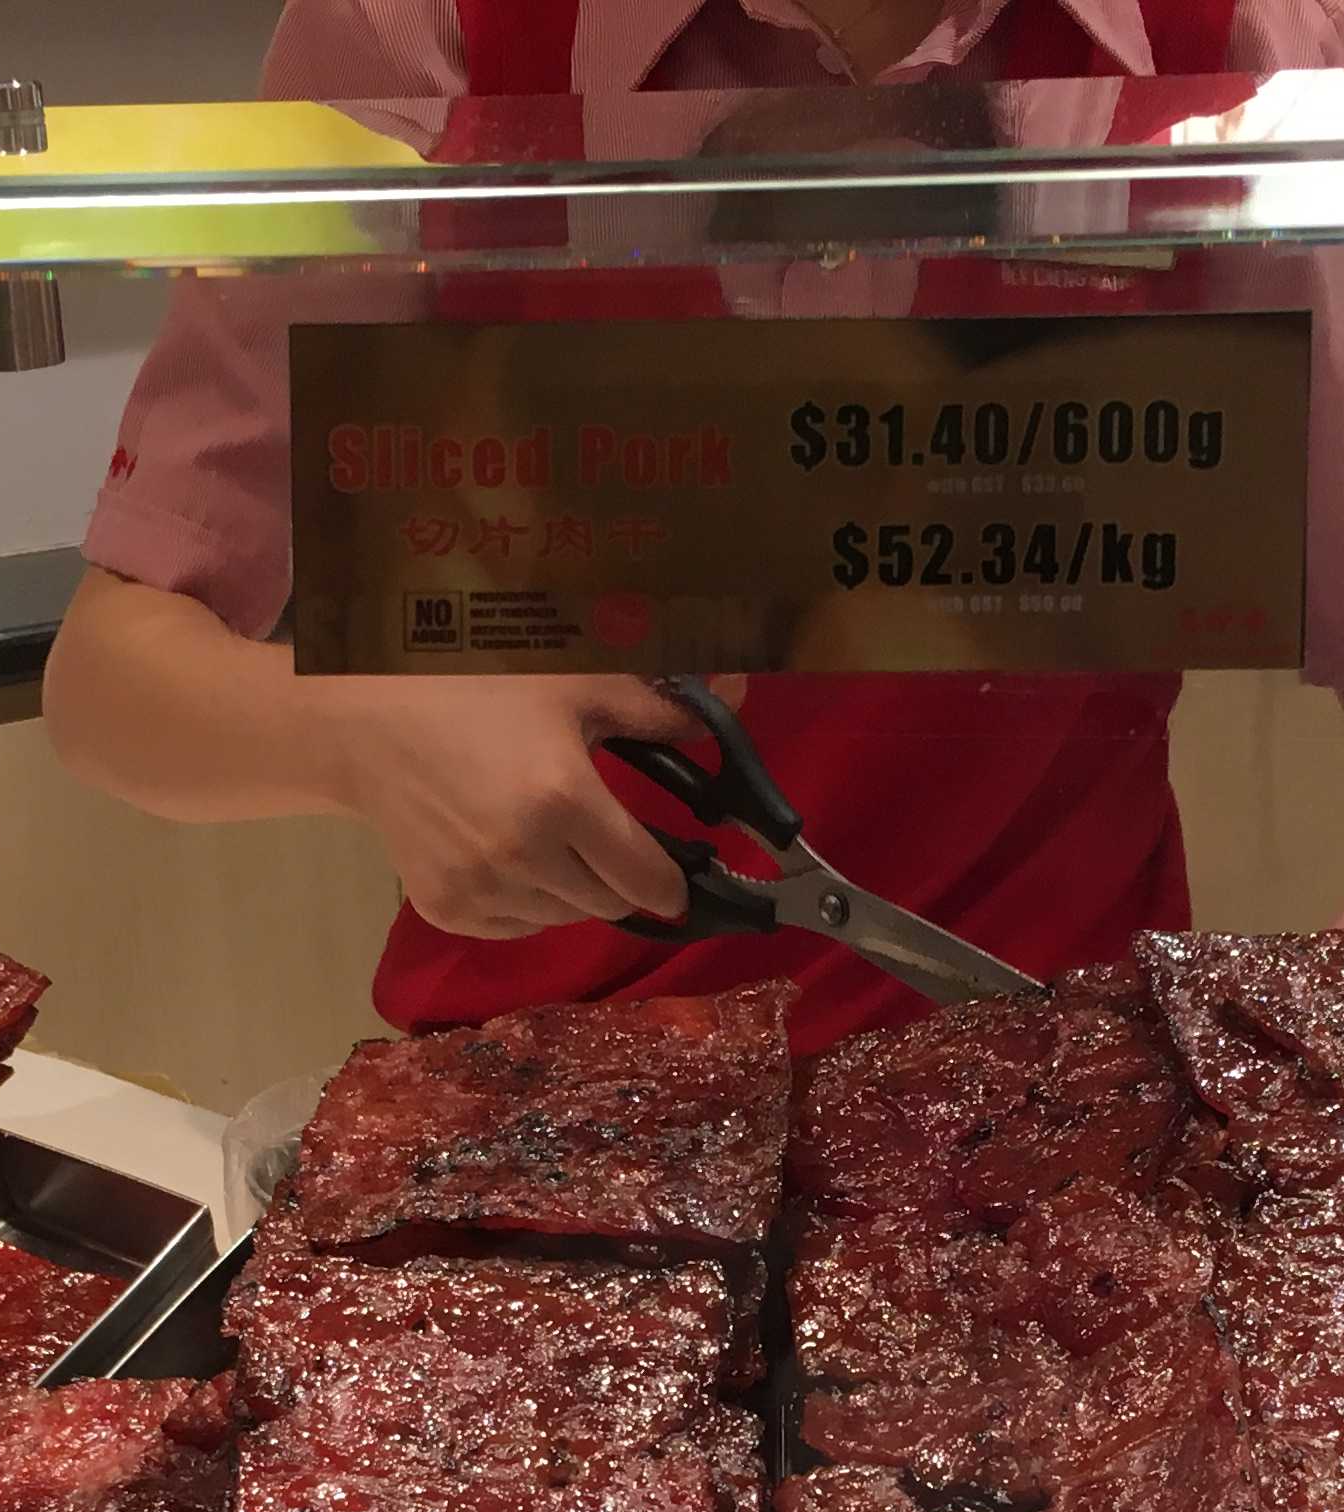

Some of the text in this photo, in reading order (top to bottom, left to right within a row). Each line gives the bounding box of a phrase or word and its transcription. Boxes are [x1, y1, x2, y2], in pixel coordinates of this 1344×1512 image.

[328, 424, 735, 493] Sliced Pork
[790, 401, 1224, 472] $31.40/600g
[399, 514, 669, 559] 切片肉干
[831, 521, 1178, 591] $52.34/kg
[414, 599, 453, 627] NO
